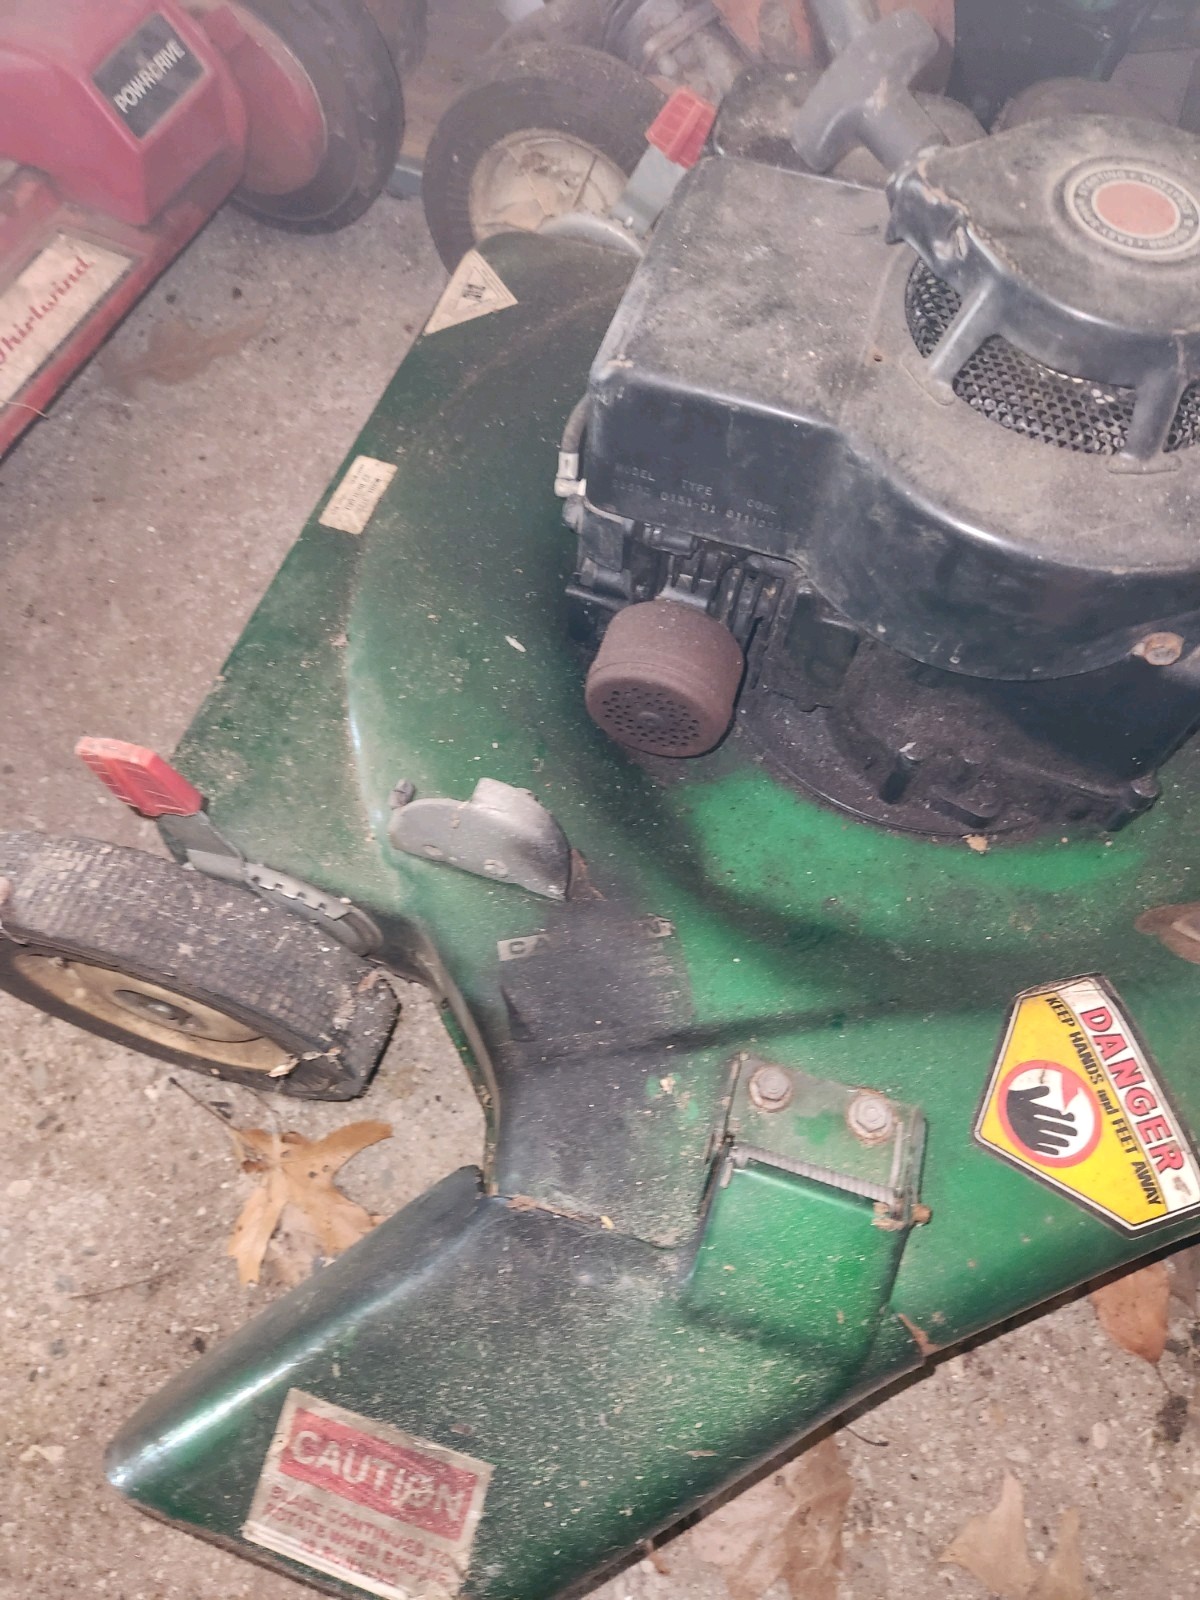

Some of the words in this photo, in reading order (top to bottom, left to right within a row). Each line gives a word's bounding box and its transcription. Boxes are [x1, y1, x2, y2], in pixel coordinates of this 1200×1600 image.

[681, 479, 713, 496] TYPE
[1046, 997, 1076, 1029] KEEP
[1069, 1031, 1104, 1085] HANDS
[1111, 1113, 1141, 1155] FEET
[1131, 1160, 1162, 1206] AWAY
[1079, 1006, 1185, 1174] DANGER
[291, 1430, 466, 1521] CAUTION
